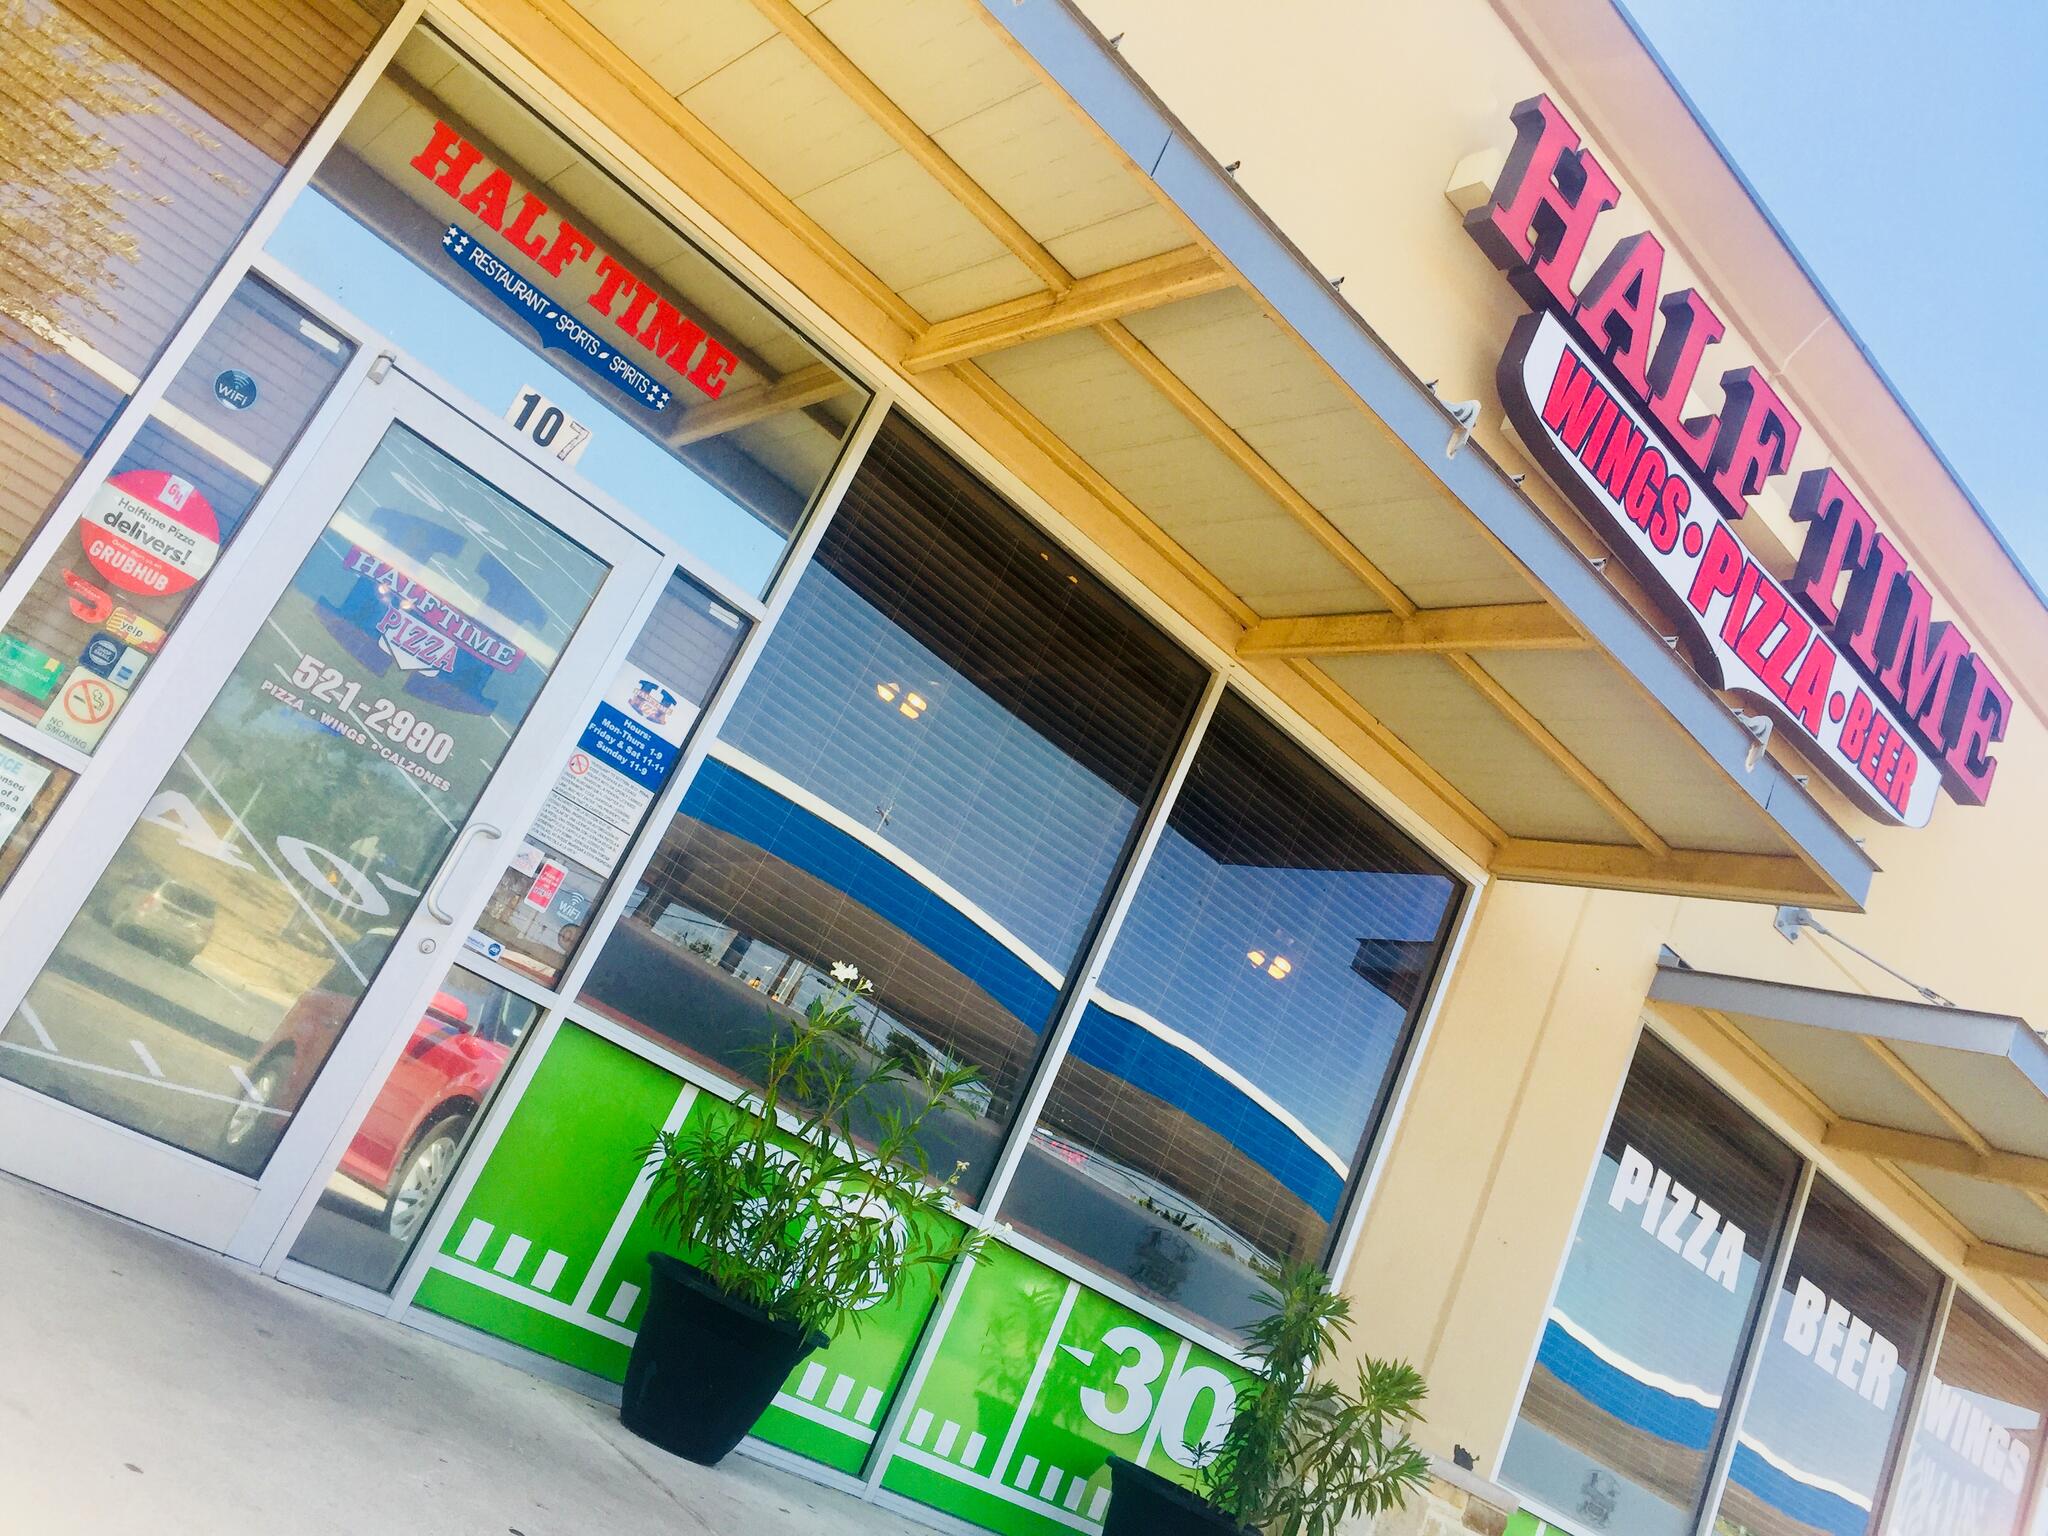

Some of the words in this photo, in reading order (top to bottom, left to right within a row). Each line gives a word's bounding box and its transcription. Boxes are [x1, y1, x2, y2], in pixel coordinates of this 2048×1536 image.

[409, 119, 597, 279] HALF
[586, 255, 742, 401] TIME
[468, 246, 551, 317] RESTAURANT
[555, 314, 601, 356] SPORTS
[608, 355, 651, 395] SPIRITS
[217, 382, 248, 406] WiFi
[512, 392, 591, 462] 107
[1490, 93, 1801, 519] HALF
[1792, 467, 2013, 806] TIME
[103, 510, 194, 566] delivers!
[116, 496, 167, 532] Halftime
[168, 523, 196, 547] Pizza
[88, 539, 170, 592] GRUBHUB
[1541, 343, 1692, 556] WINGS
[1686, 518, 1839, 741] PIZZA
[1836, 699, 1920, 816] BEER
[119, 619, 144, 639] yelp
[350, 550, 518, 667] HALFTIME
[375, 607, 459, 673] PIZZA
[44, 723, 88, 750] SMOKING
[49, 715, 64, 728] NO
[260, 679, 304, 712] PIZZA
[319, 711, 366, 746] WINGS
[380, 745, 451, 792] CALZONES
[291, 653, 455, 766] 521-2990
[601, 717, 646, 750] Mon-Thurs
[650, 748, 663, 760] 1-9
[623, 719, 652, 741] Hours:
[588, 722, 617, 745] Friday
[616, 740, 625, 749] &
[625, 745, 641, 760] Sat
[642, 756, 665, 774] 11-11
[596, 740, 628, 764] Sunday
[630, 760, 648, 776] 11-9
[1607, 1143, 1747, 1293] PIZZA
[1782, 1274, 1899, 1410] BEER
[1923, 1374, 2031, 1497] WINGS
